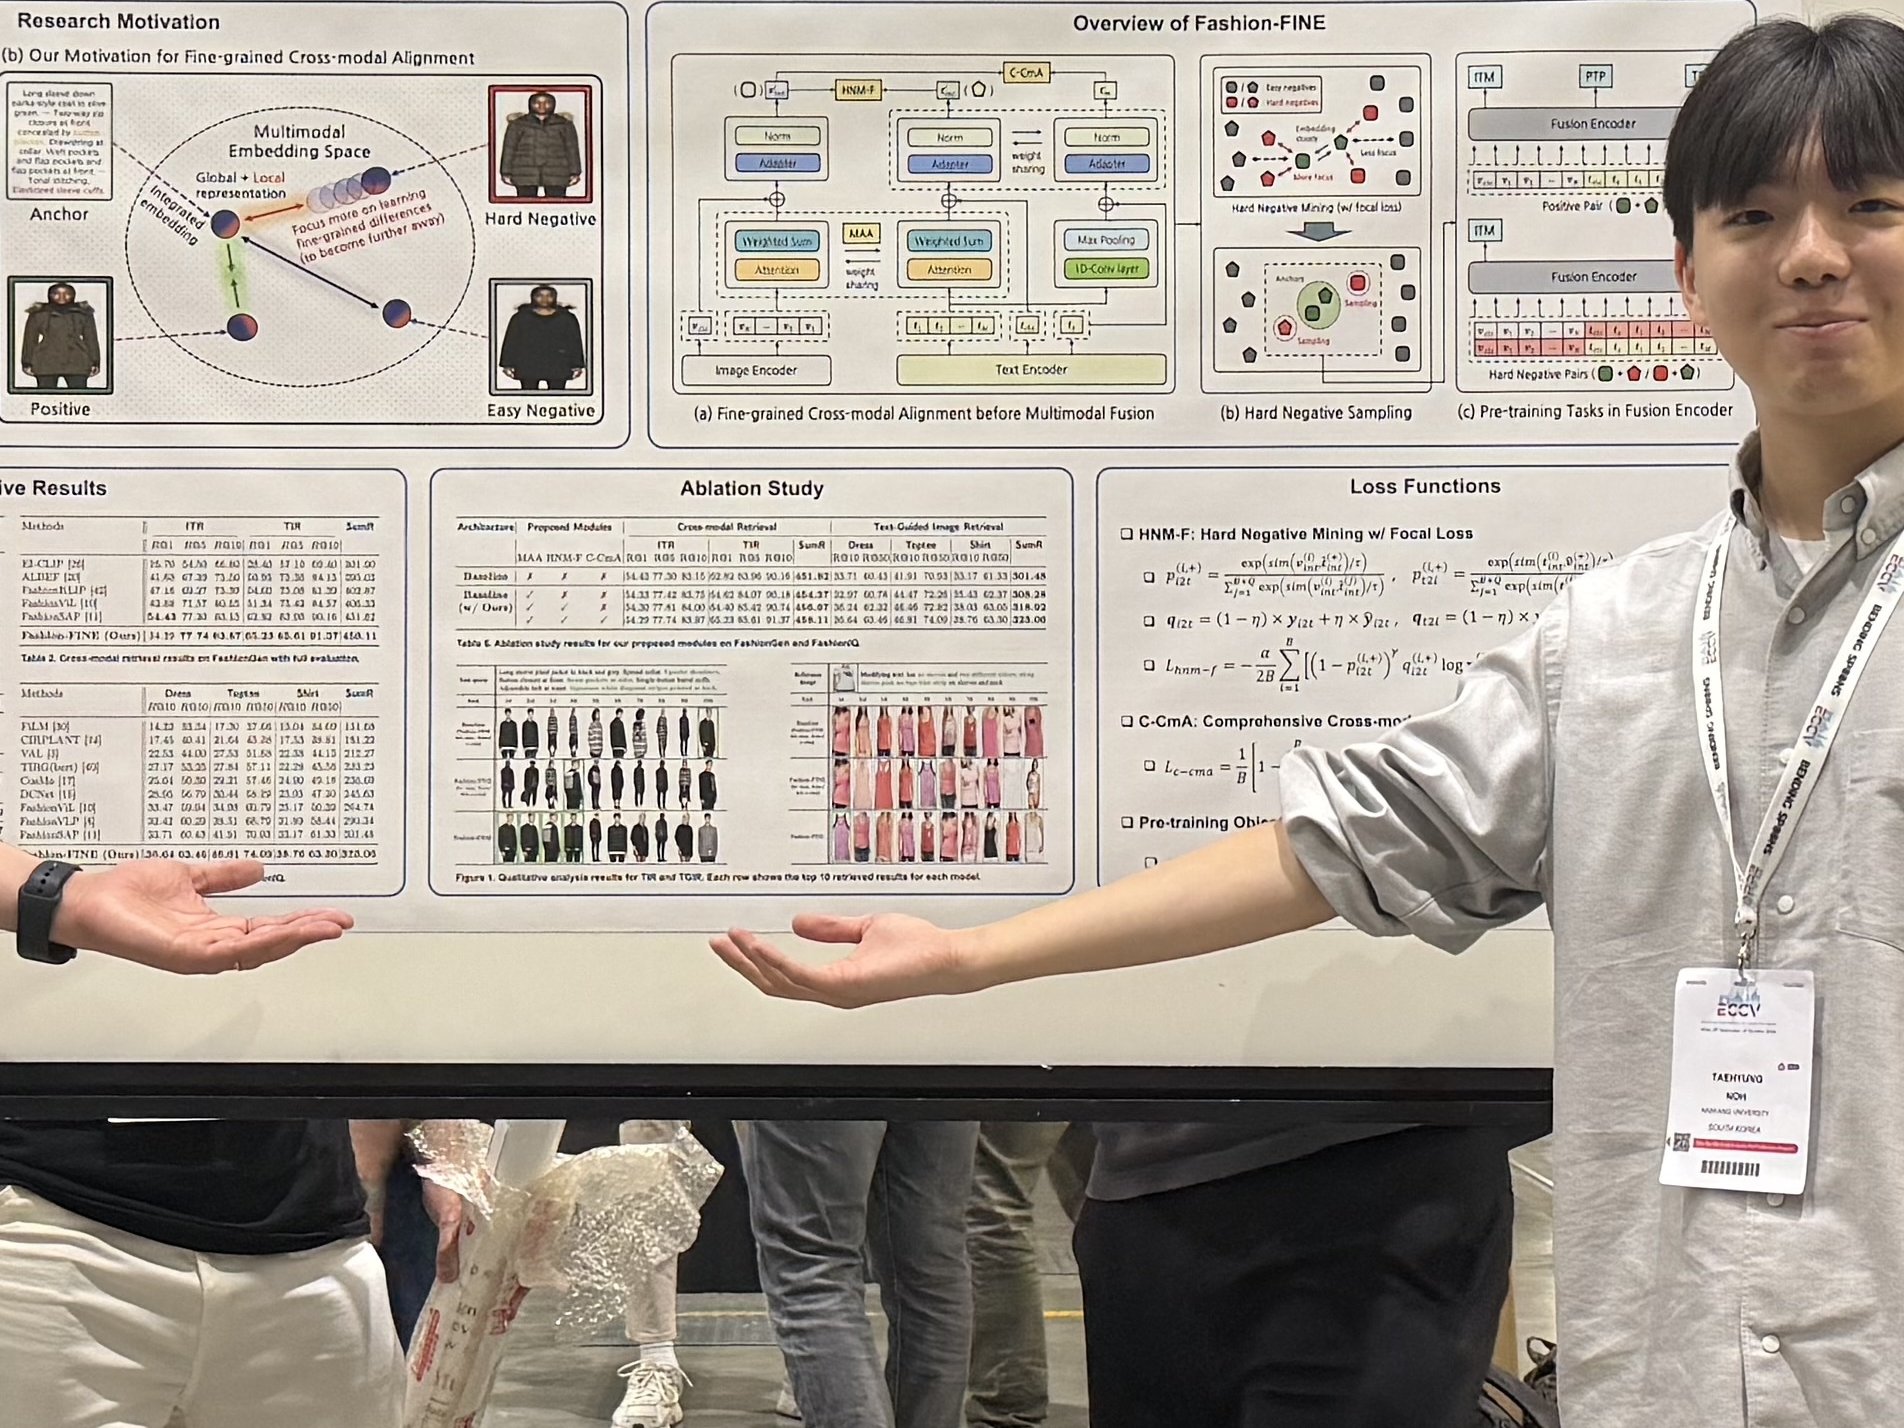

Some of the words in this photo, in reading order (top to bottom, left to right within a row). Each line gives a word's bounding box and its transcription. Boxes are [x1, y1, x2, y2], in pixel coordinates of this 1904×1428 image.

[18, 12, 110, 29] Research
[118, 13, 220, 30] Motivation
[1073, 15, 1164, 31] Overview
[1170, 15, 1190, 31] of
[1195, 14, 1326, 31] Fashion-FINE
[2, 47, 24, 65] (b)
[30, 49, 60, 64] Our
[64, 48, 152, 65] Motivation
[157, 49, 179, 63] for
[185, 49, 283, 66] Fine-grained
[289, 50, 387, 64] Cross-modal
[392, 50, 475, 67] Alignment
[254, 124, 345, 139] Multimodal
[1551, 118, 1588, 129] Fusion
[1590, 118, 1636, 129] Encoder
[229, 143, 319, 160] Embedding
[325, 144, 371, 160] Space
[196, 171, 236, 183] Global
[253, 171, 285, 183] Local
[196, 188, 286, 203] representation
[29, 206, 89, 221] Anchor
[150, 185, 206, 230] Integrated
[291, 220, 326, 236] Focus
[328, 210, 359, 226] more
[361, 205, 378, 216] on
[378, 188, 428, 212] learning
[139, 198, 199, 247] embedding
[296, 221, 367, 250] fine-grained
[368, 203, 433, 228] differences
[485, 211, 522, 225] Hard
[528, 211, 596, 228] Negative
[299, 251, 318, 266] (to
[318, 238, 367, 259] become
[367, 223, 411, 245] further
[410, 213, 446, 233] away)
[716, 365, 749, 378] Image
[752, 365, 798, 376] Encoder
[996, 364, 1019, 375] Text
[1023, 364, 1068, 375] Encoder
[31, 401, 90, 416] Positive
[486, 403, 521, 422] Easy
[526, 402, 597, 421] Negative
[694, 405, 712, 422] (a)
[718, 406, 803, 423] Fine-grained
[808, 405, 894, 420] Cross-modal
[898, 406, 972, 423] Alignment
[976, 405, 1021, 420] before
[1026, 405, 1105, 420] Multimodal
[1110, 406, 1154, 420] Fusion
[1221, 404, 1239, 422] (b)
[1245, 405, 1277, 420] Hard
[1283, 405, 1343, 422] Negative
[1348, 405, 1412, 421] Sampling
[1458, 403, 1475, 420] (c)
[1480, 404, 1562, 420] Pre-training
[1566, 403, 1604, 418] Tasks
[1608, 403, 1620, 417] in
[1626, 403, 1670, 418] Fusion
[1676, 402, 1733, 417] Encoder
[33, 480, 107, 496] Results
[680, 480, 761, 496] Ablation
[768, 480, 824, 500] Study
[1351, 478, 1397, 494] Loss
[1404, 478, 1501, 494] Functions
[1139, 528, 1194, 541] HNM-F:
[1201, 528, 1236, 540] Hard
[1242, 528, 1307, 543] Negative
[1313, 527, 1363, 543] Mining
[1368, 527, 1385, 540] w/
[1390, 527, 1431, 540] Focal
[1436, 527, 1473, 539] Loss
[1139, 715, 1197, 728] C-CmA:
[1203, 714, 1322, 731] Comprehensive
[1140, 816, 1228, 832] Pre-training
[1717, 1003, 1761, 1018] ECCV
